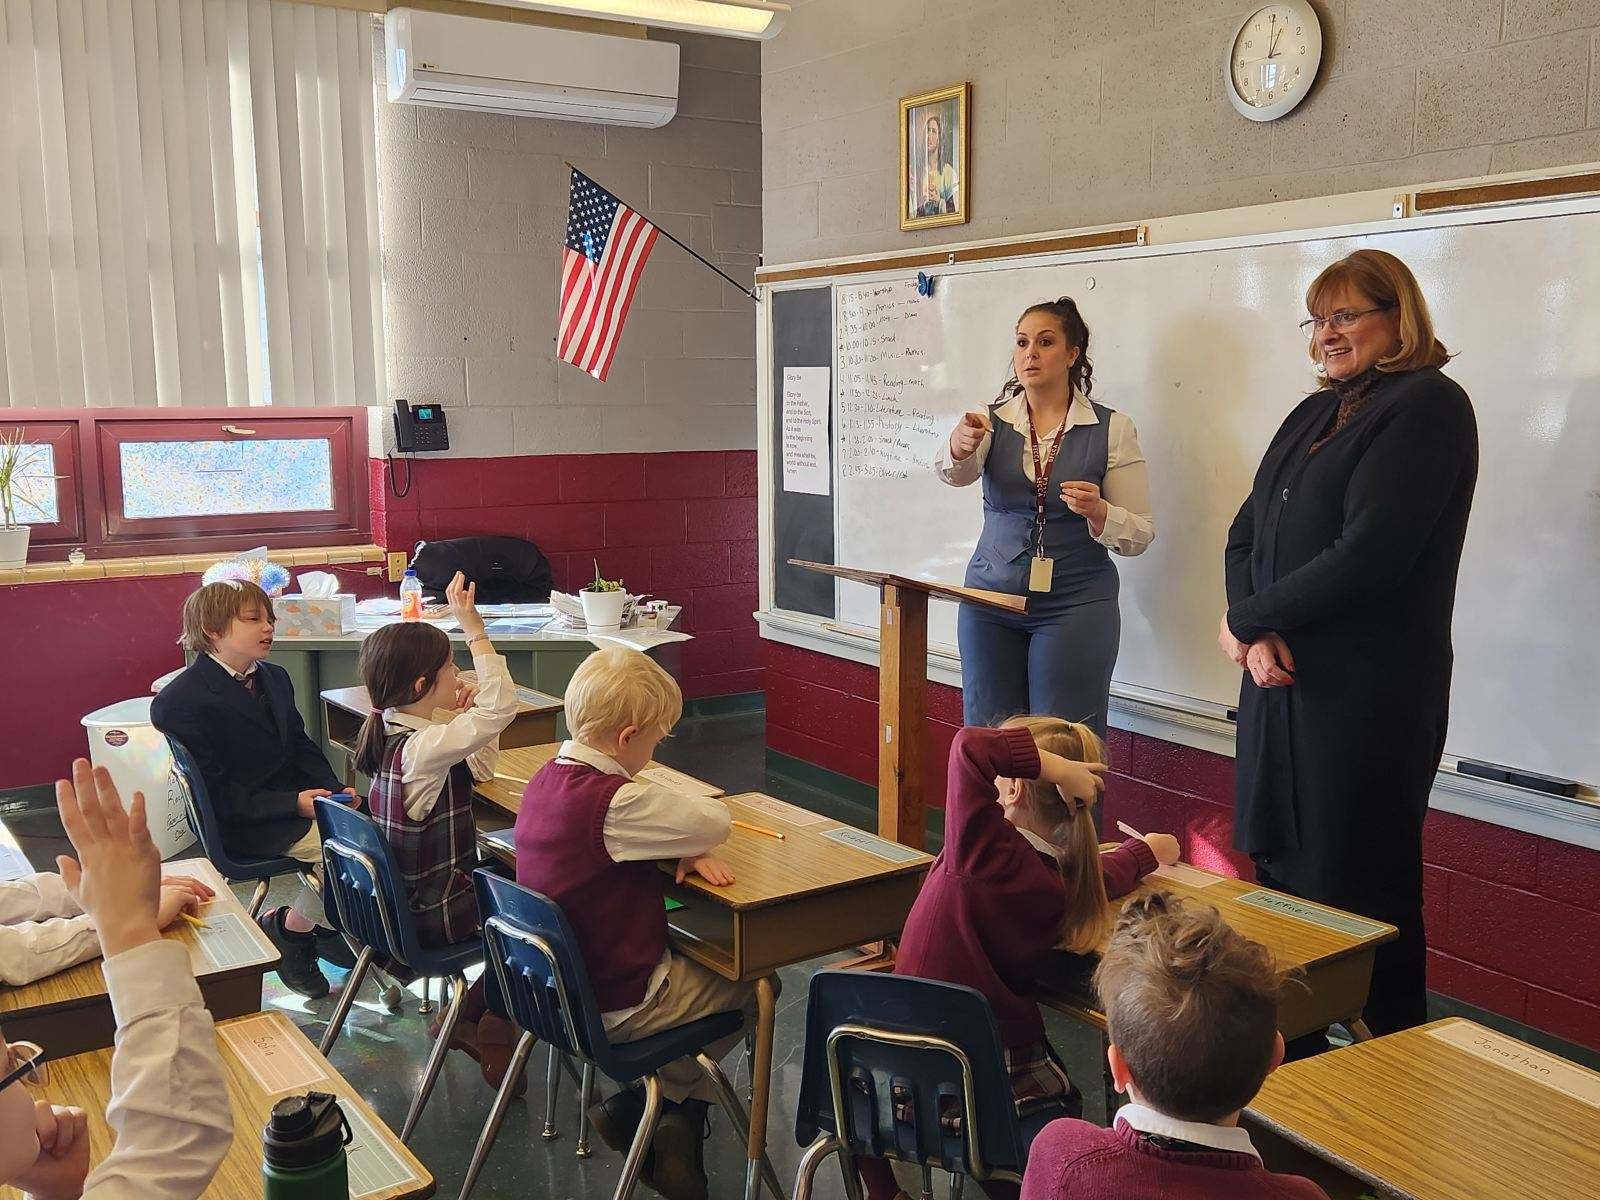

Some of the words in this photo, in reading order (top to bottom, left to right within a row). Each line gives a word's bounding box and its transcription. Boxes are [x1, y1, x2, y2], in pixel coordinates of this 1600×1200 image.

[1285, 16, 1288, 24] 1
[1296, 26, 1301, 36] 2
[1244, 41, 1252, 49] 10
[1300, 46, 1306, 55] 3
[1240, 60, 1244, 68] 9
[1294, 66, 1300, 76] 4
[1244, 78, 1248, 86] 8
[1283, 83, 1288, 92] 5
[1268, 91, 1273, 100] 6
[1473, 1037, 1551, 1075] Jonathan
